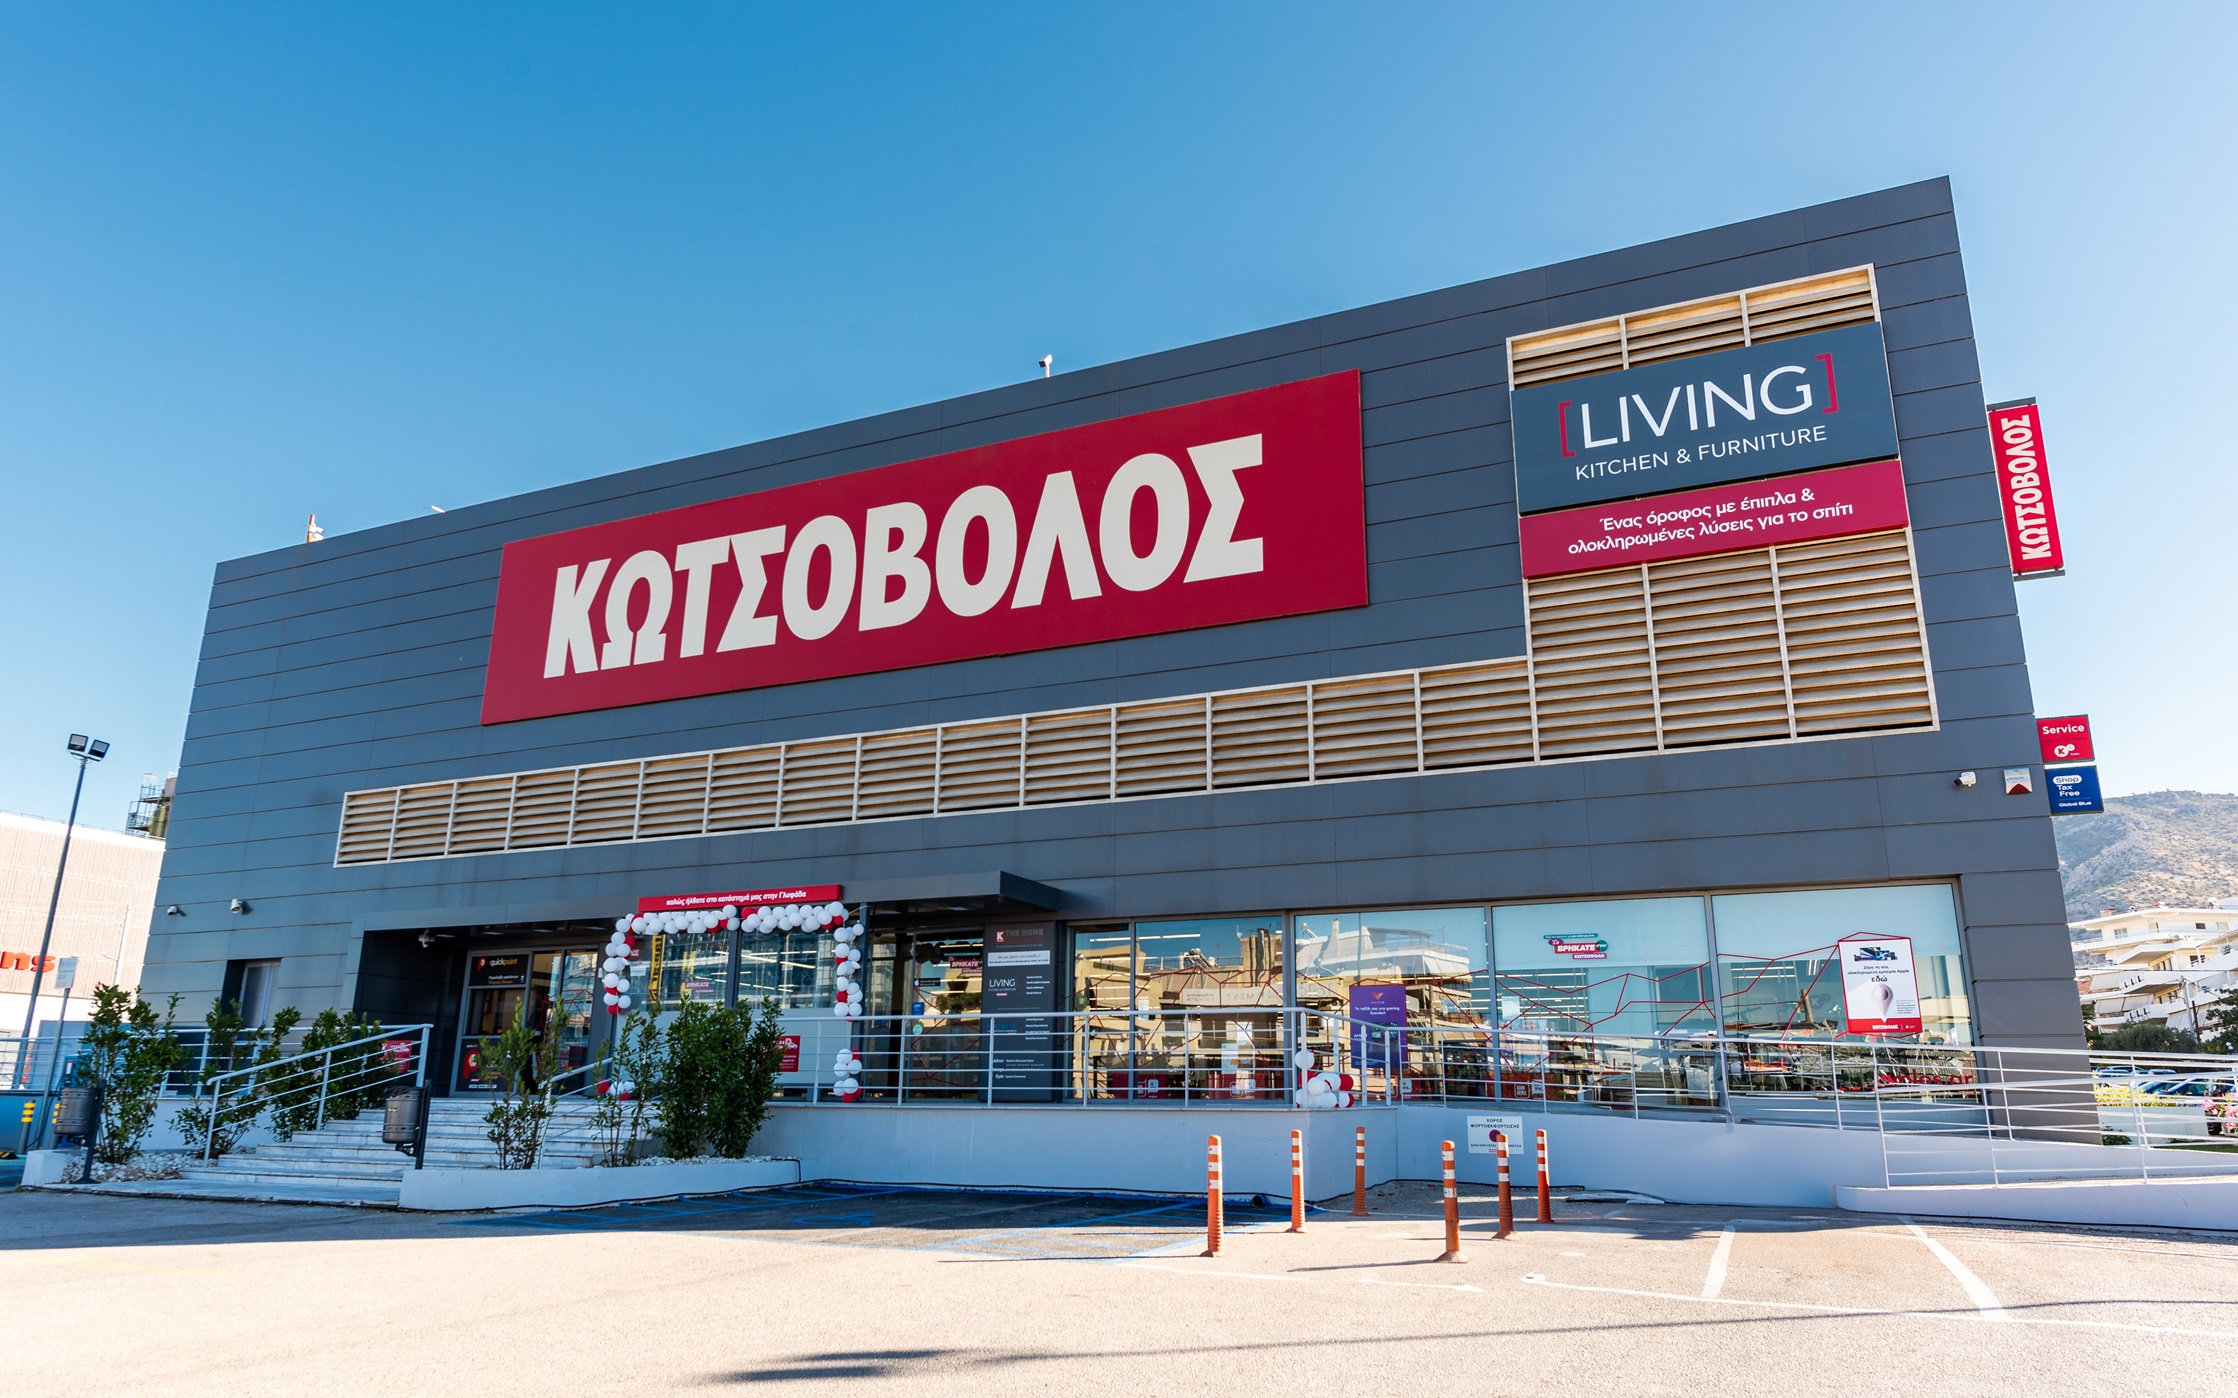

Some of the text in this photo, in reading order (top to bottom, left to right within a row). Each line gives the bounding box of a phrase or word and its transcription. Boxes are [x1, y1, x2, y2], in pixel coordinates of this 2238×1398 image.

[1575, 425, 1827, 480] KITCHEN & FURNITURE
[1599, 488, 1815, 531] Ένας όροφος με έπιπλα &
[2001, 414, 2052, 560] ΚΩΤΣΟΒΟΛΟΣ
[1568, 503, 1853, 554] ολοκληρωμένες λύσεις για το σπίτι
[543, 433, 1264, 679] ΚΩΤΣΟΒΟΛΟΣ
[2042, 724, 2084, 735] Service
[2055, 775, 2079, 784] Shop
[1557, 944, 1596, 952] ΒΡΗΚΑΤΕ
